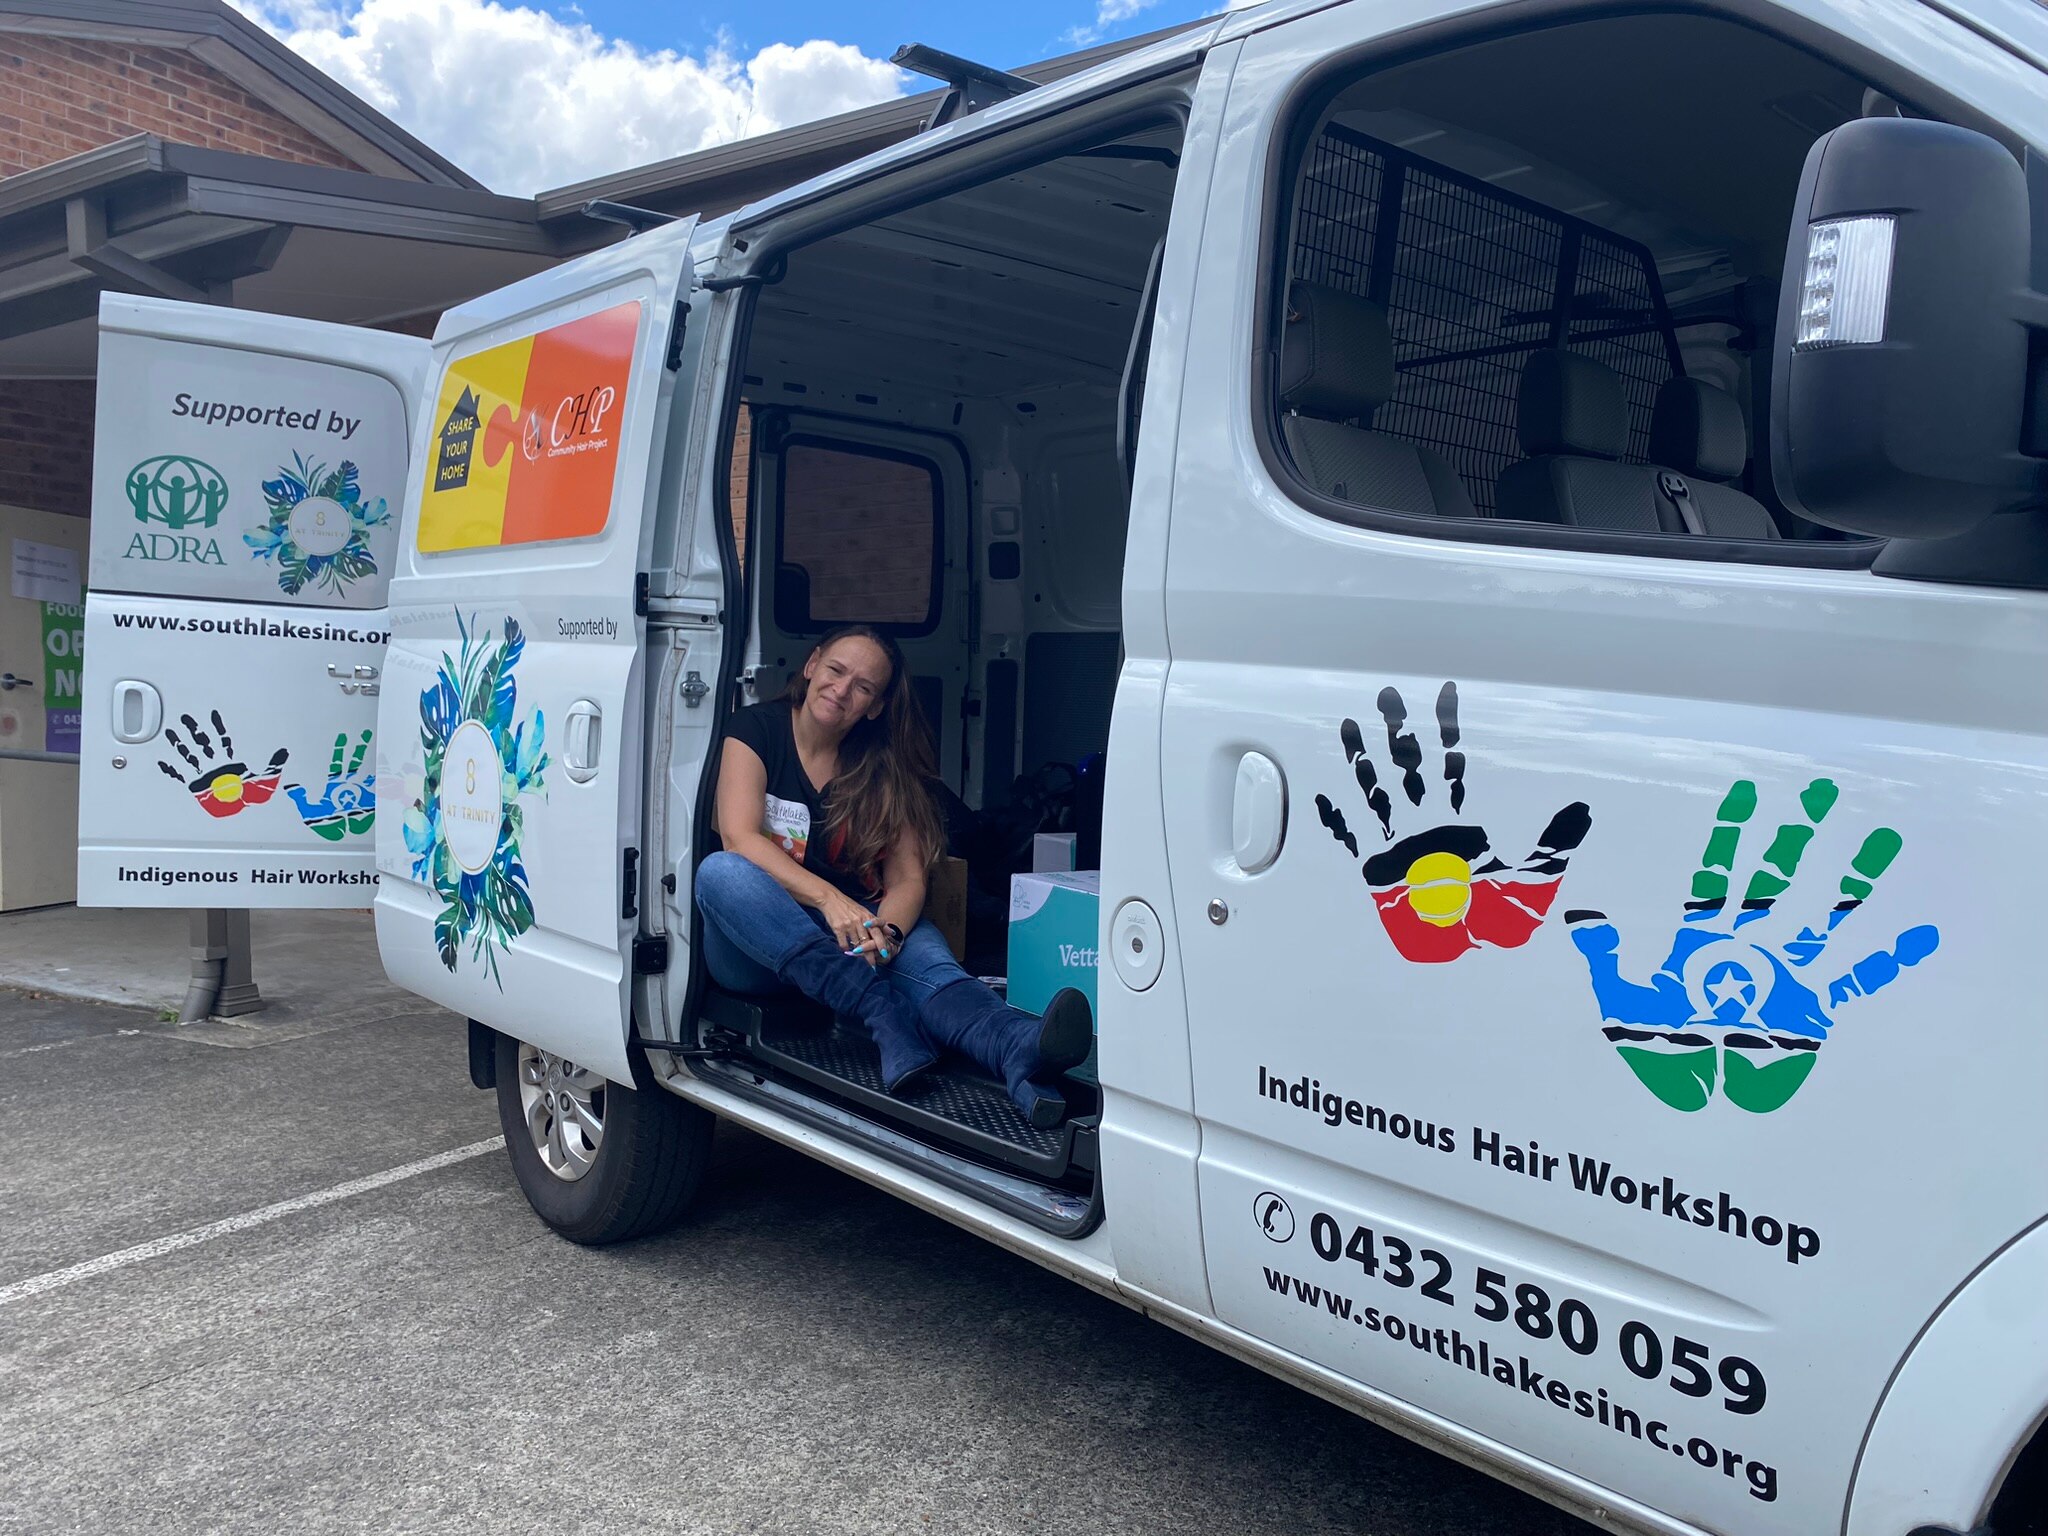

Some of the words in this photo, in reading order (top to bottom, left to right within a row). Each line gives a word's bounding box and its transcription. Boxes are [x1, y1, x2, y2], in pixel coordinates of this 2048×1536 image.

[171, 393, 321, 431] Supported
[327, 411, 361, 440] by
[447, 416, 474, 436] SHARE
[551, 386, 615, 447] CHP
[445, 441, 468, 458] YOUR
[441, 464, 465, 481] HOME
[316, 511, 326, 527] 8
[121, 532, 228, 566] ADRA
[558, 617, 604, 639] Supported
[606, 619, 618, 640] by
[465, 758, 476, 795] 8
[446, 805, 457, 818] AT
[462, 805, 496, 825] TRINITY
[118, 867, 239, 886] Indigenous
[251, 869, 294, 884] Hair
[1257, 1066, 1457, 1153] Indigenous
[1473, 1127, 1560, 1182] Hair
[1567, 1152, 1821, 1265] Workshop
[1310, 1212, 1455, 1307] 0432
[1474, 1266, 1599, 1356] 580
[1619, 1320, 1768, 1416] 059
[1262, 1265, 1778, 1503] www.southlakesinc.org
